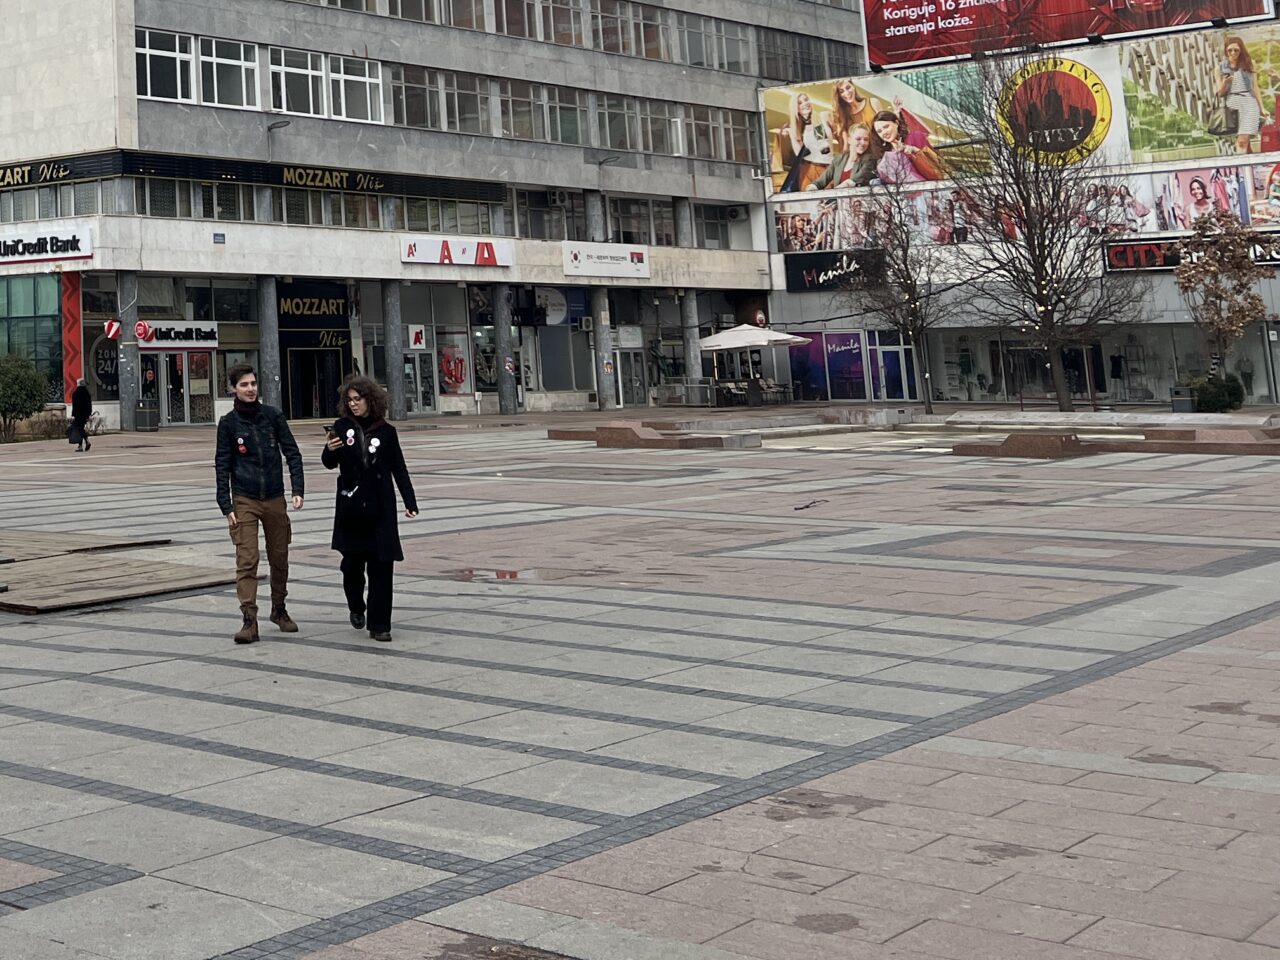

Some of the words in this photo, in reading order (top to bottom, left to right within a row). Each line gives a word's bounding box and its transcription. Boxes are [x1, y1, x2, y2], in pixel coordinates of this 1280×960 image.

[883, 1, 936, 20] Koriguje
[884, 19, 936, 37] starenja
[38, 162, 70, 182] Niš
[283, 167, 349, 189] MOZZART
[356, 174, 385, 190] Niš
[49, 234, 81, 253] Bank
[1108, 243, 1168, 267] CITY
[802, 254, 861, 288] Manila
[280, 297, 345, 315] MOZZART
[154, 327, 194, 341] UniCredit
[194, 327, 217, 341] Bank
[97, 349, 117, 359] ZON
[827, 338, 860, 354] Manila
[97, 359, 117, 374] 24/
